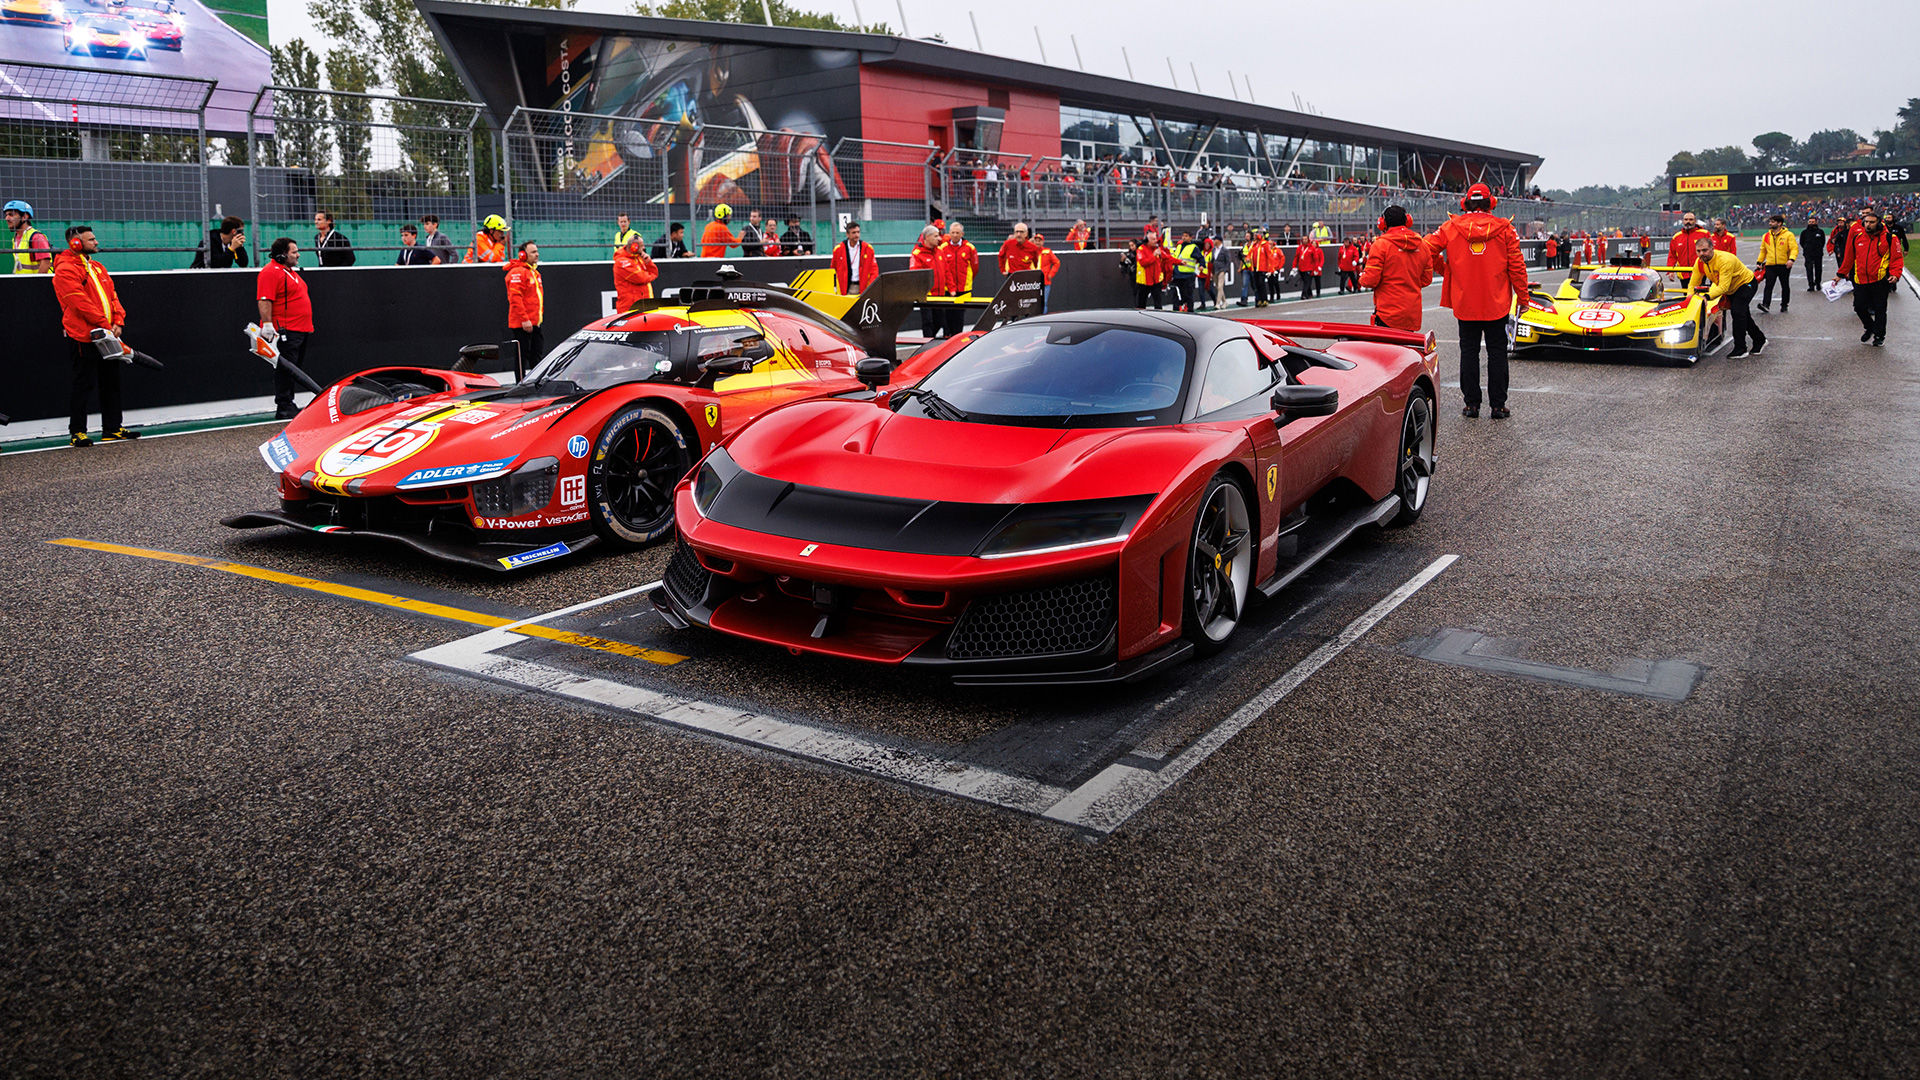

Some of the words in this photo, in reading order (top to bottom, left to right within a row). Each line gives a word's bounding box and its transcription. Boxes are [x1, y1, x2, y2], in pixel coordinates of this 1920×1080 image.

[560, 39, 571, 94] COSTA
[562, 100, 574, 170] CHECCO
[556, 147, 566, 190] MUSEO
[1755, 171, 1848, 187] HIGH-TECH
[1852, 168, 1910, 183] TYRES
[1016, 281, 1042, 291] Santander
[727, 292, 752, 303] ADLER
[1580, 311, 1613, 321] 83
[490, 417, 540, 440] RICHARD
[606, 410, 640, 445] MICHELIN
[347, 427, 416, 453] 50
[572, 437, 586, 459] hp
[407, 466, 464, 482] ADLER
[485, 518, 541, 529] V-Power
[545, 511, 588, 526] VISTAJET
[521, 547, 560, 562] MICHELIN
